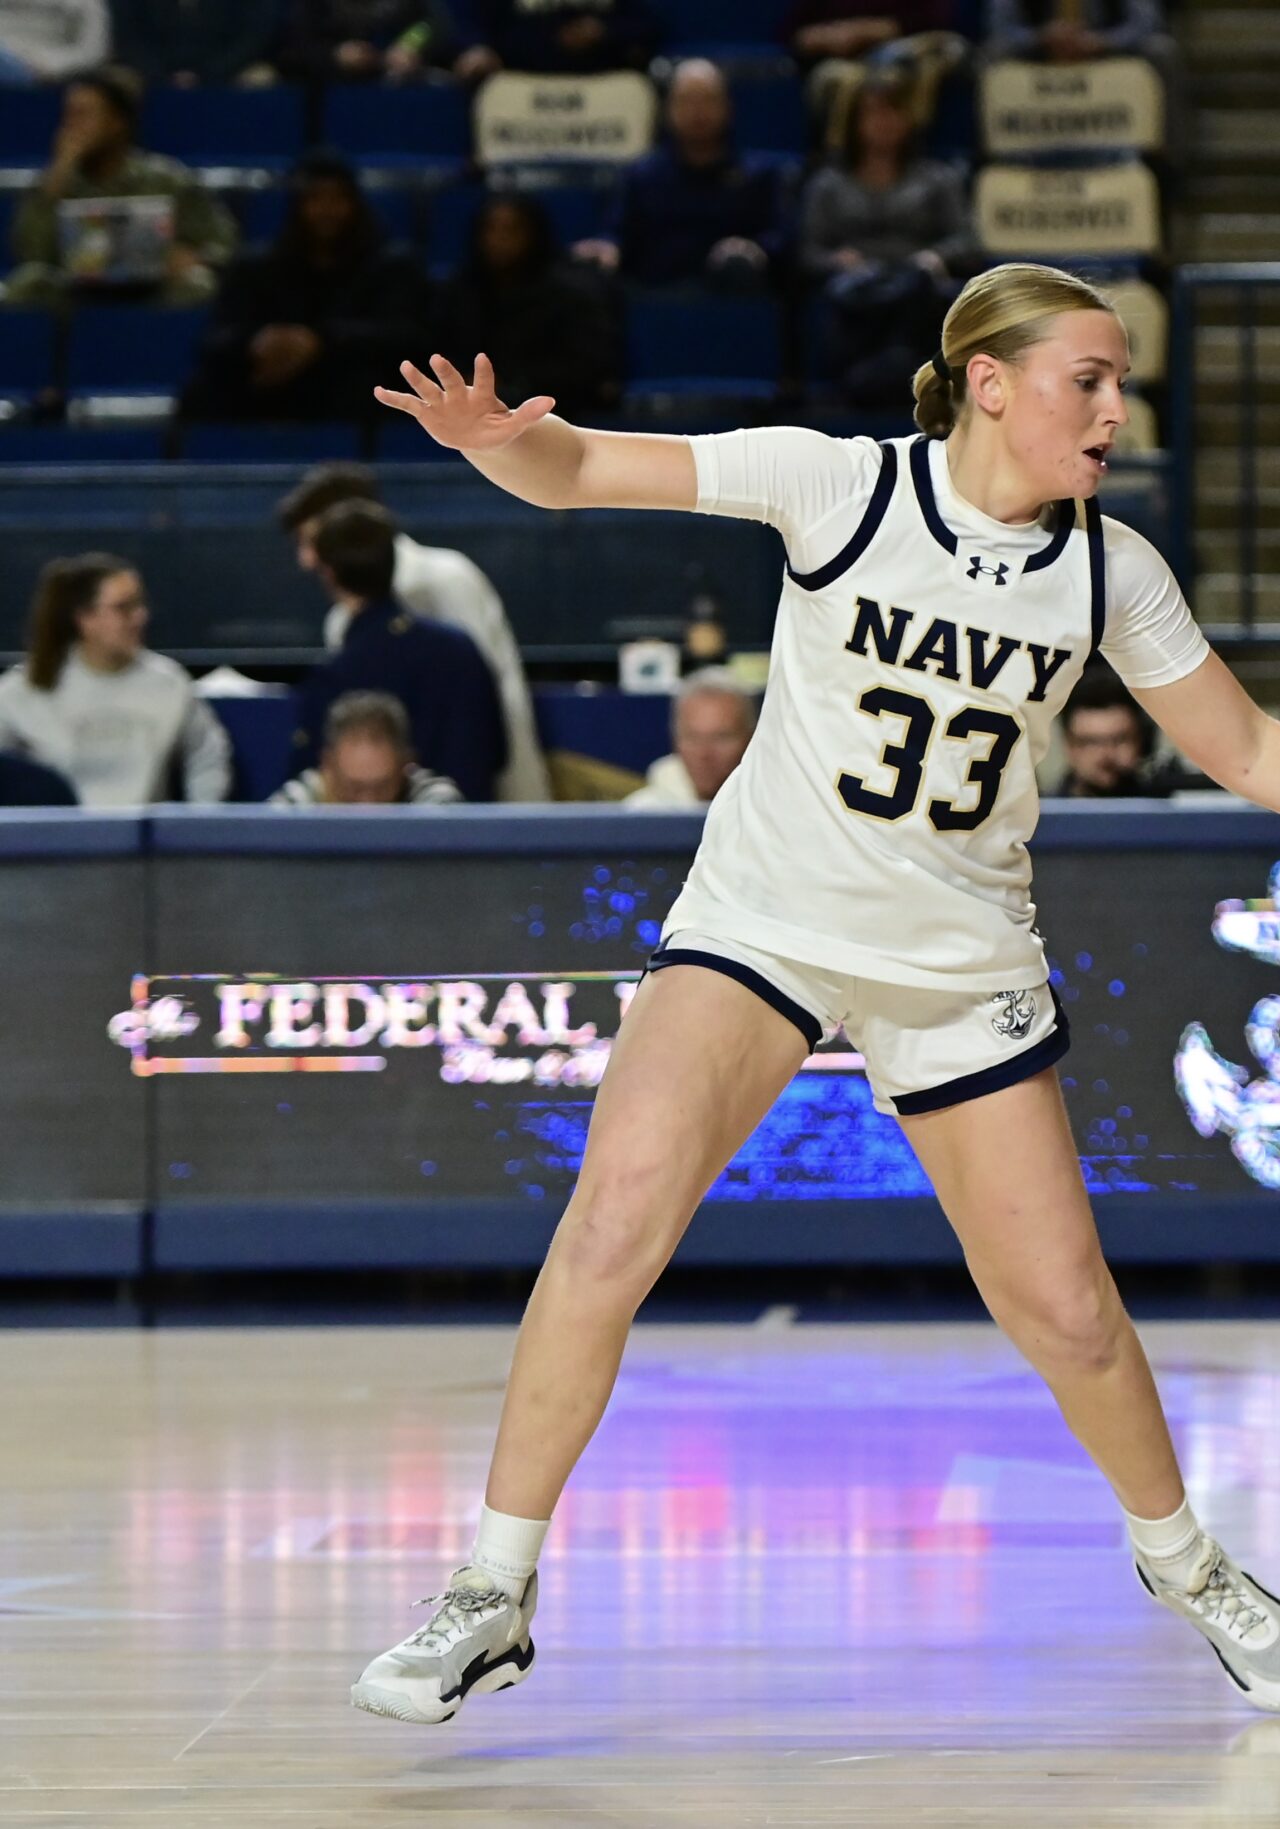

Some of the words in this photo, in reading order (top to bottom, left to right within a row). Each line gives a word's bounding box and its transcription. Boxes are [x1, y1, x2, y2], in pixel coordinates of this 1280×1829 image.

[845, 596, 1072, 702] NAVY
[833, 682, 1025, 834] 33
[213, 981, 598, 1048] FEDERAL
